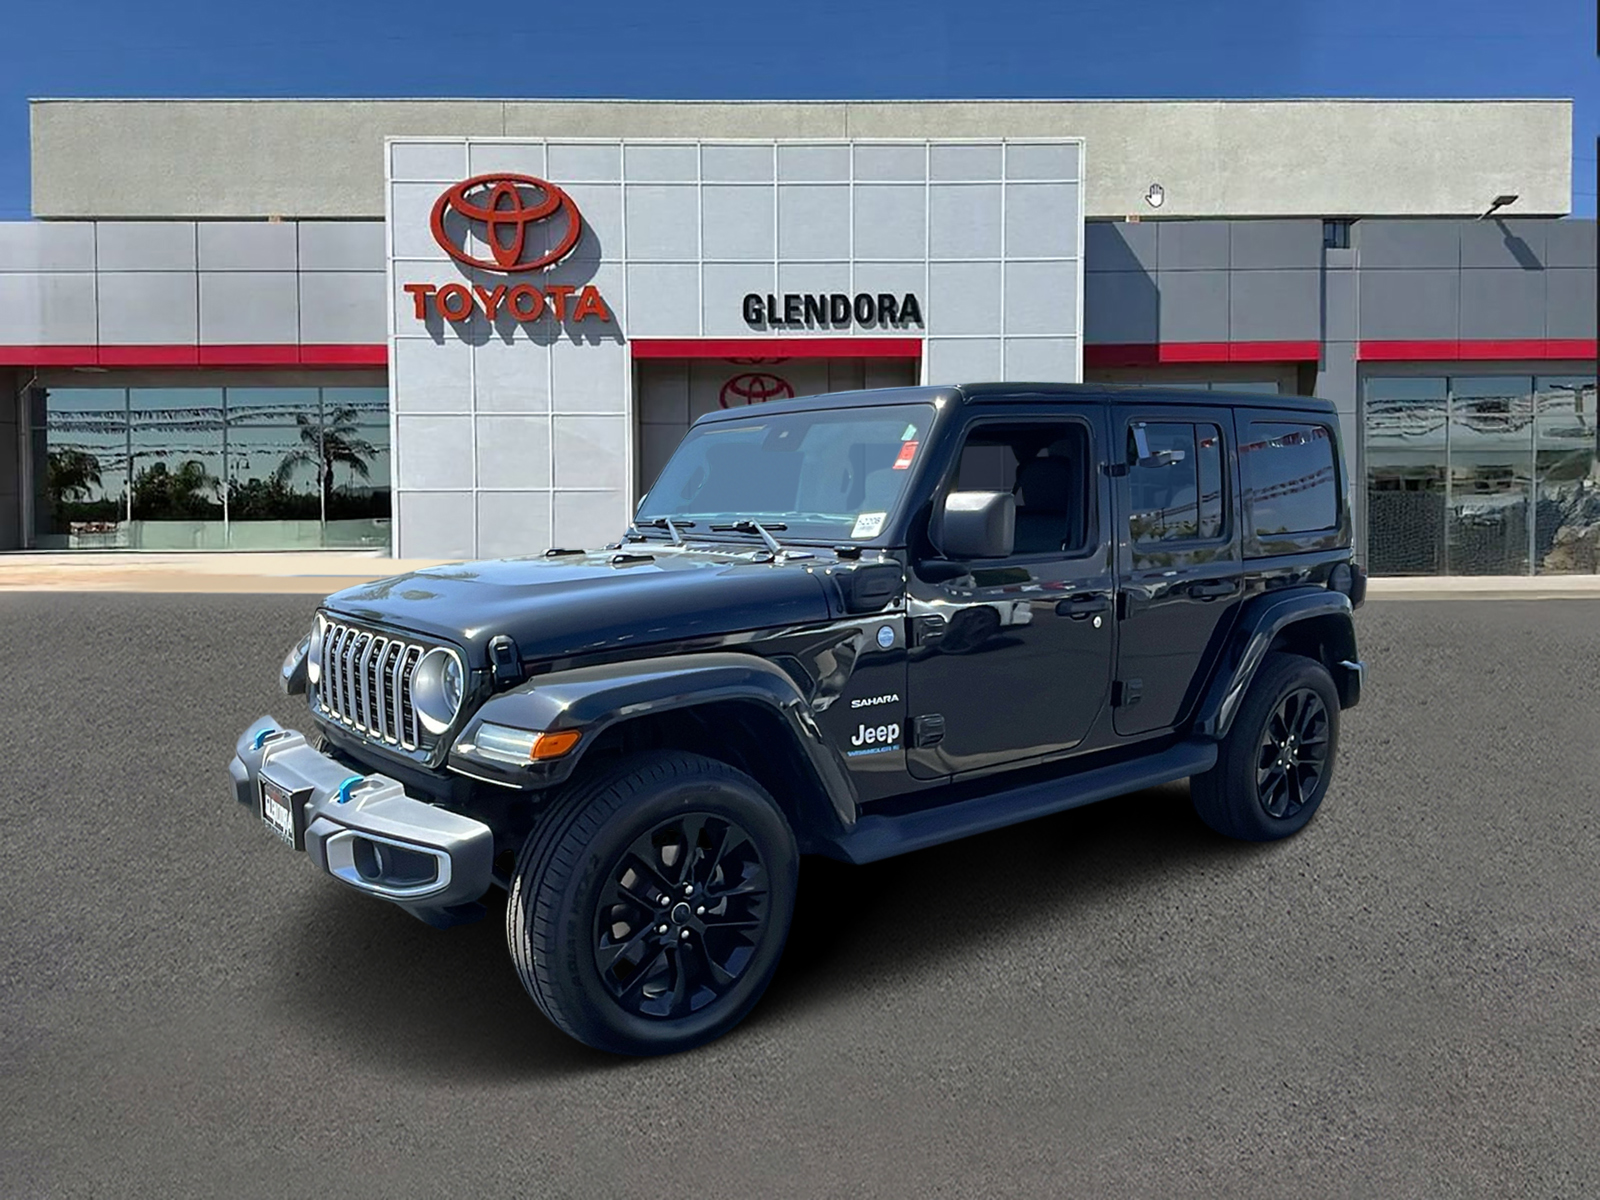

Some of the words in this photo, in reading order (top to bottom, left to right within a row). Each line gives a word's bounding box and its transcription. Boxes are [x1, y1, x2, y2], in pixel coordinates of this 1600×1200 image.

[403, 283, 610, 322] TOYOTA
[742, 293, 922, 326] GLENDORA
[851, 694, 899, 708] SAHARA
[851, 723, 899, 745] Jeep
